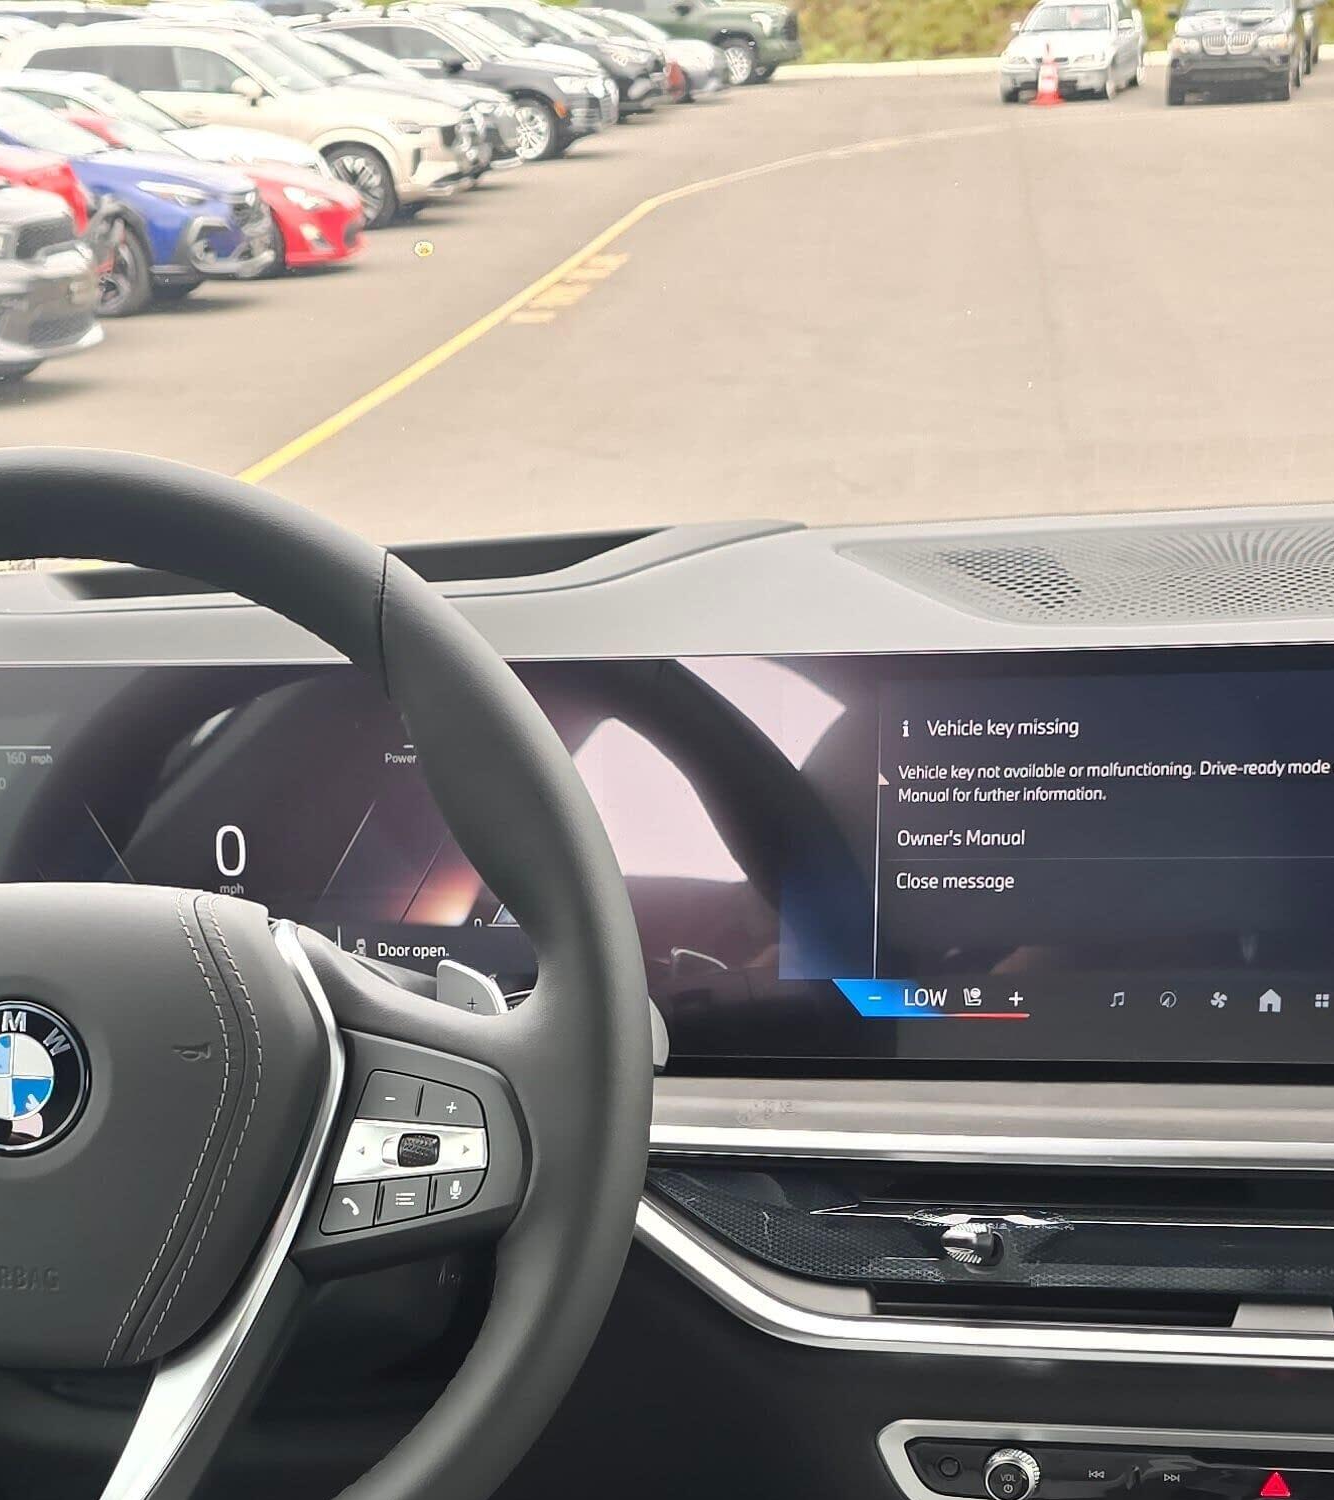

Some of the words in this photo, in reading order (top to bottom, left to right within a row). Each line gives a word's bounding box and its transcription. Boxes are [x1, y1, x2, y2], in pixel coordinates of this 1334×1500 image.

[926, 719, 983, 736] Vehicle
[987, 719, 1014, 739] key
[1017, 718, 1079, 738] missing
[6, 751, 27, 765] 160
[31, 753, 53, 765] mph
[385, 752, 417, 764] Power
[898, 764, 947, 780] Vehicle
[951, 764, 974, 781] key
[978, 765, 1001, 779] not
[1004, 762, 1066, 779] available
[1069, 765, 1084, 778] or
[1087, 761, 1196, 779] malfunctioning.
[1199, 759, 1284, 777] Drive-ready
[1288, 760, 1330, 774] mode
[898, 788, 949, 802] Manual
[952, 788, 971, 802] for
[974, 787, 1020, 802] further
[1023, 786, 1107, 802] information.
[897, 829, 963, 847] Owner's
[966, 828, 1026, 847] Manual
[215, 824, 246, 877] 0
[219, 883, 244, 895] mph
[896, 872, 939, 891] Close
[942, 874, 1015, 893] message
[377, 942, 409, 958] Door
[412, 943, 450, 960] open.
[903, 988, 947, 1007] LOW
[1000, 1473, 1016, 1482] VOL
